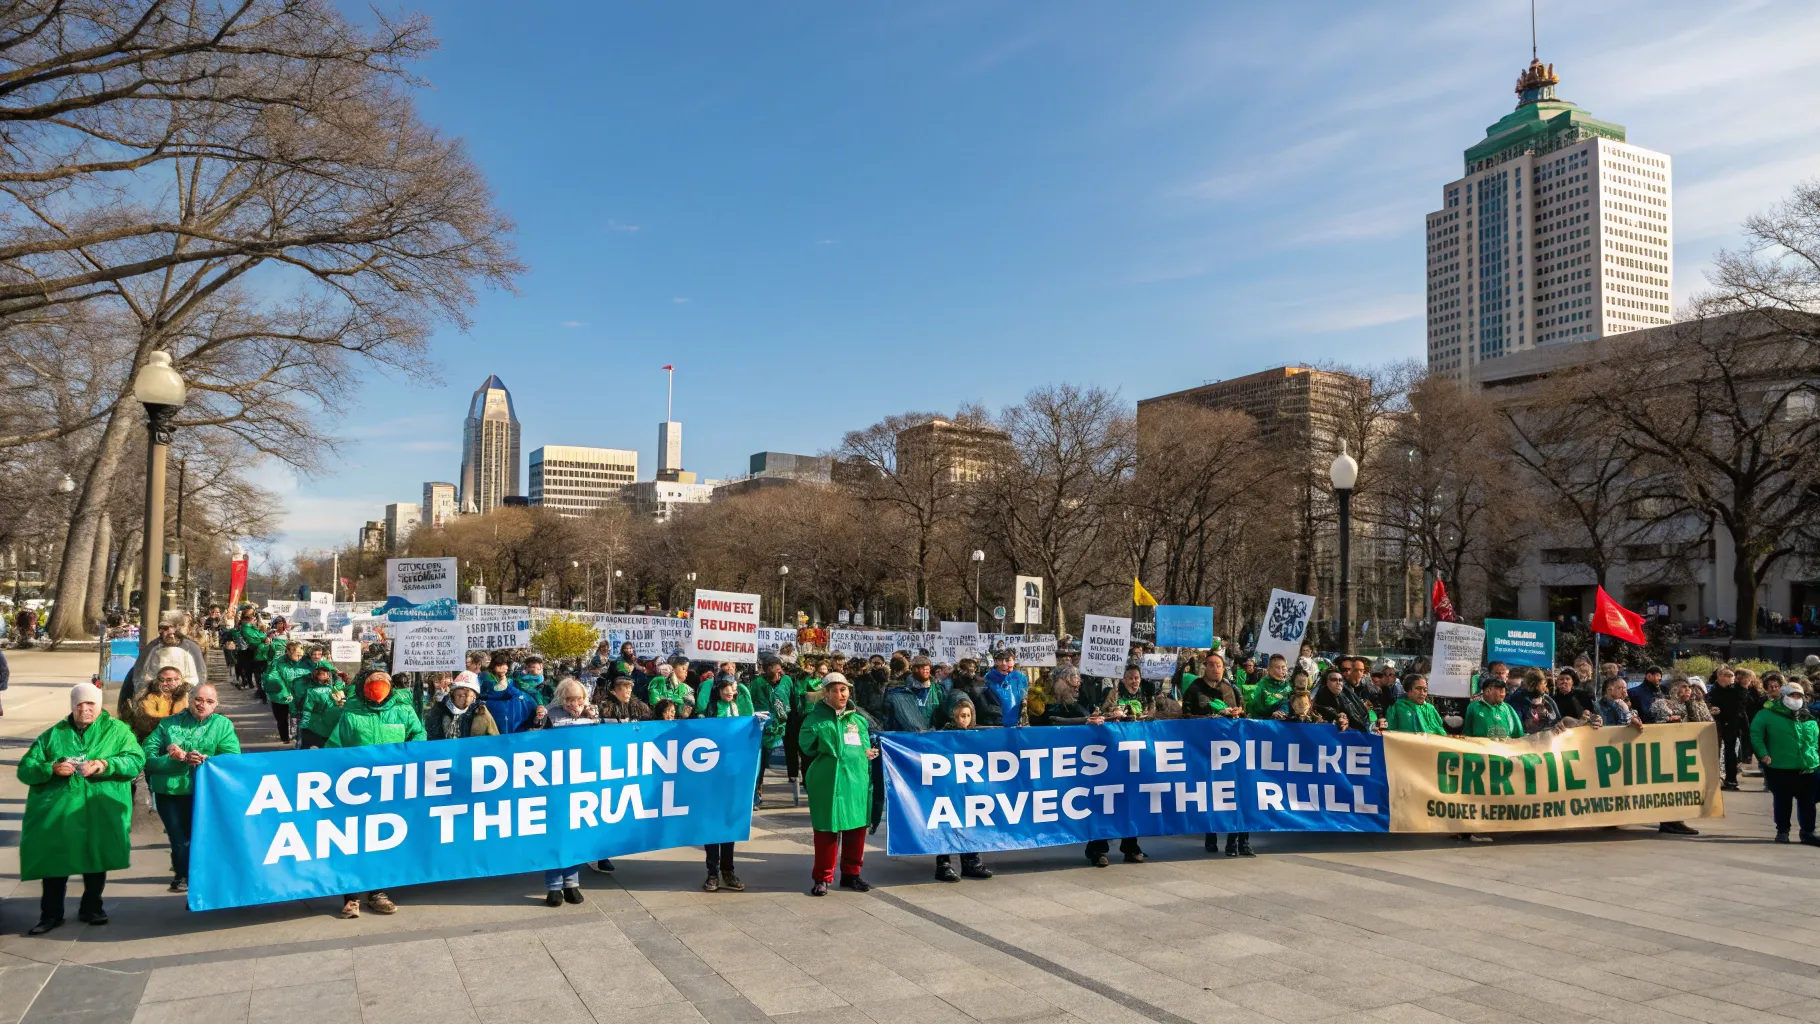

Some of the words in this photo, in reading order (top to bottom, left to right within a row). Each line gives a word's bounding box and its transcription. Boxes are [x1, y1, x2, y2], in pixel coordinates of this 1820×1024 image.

[244, 759, 453, 817] ARCTIE
[471, 737, 721, 794] DRILLING
[927, 784, 1127, 831] ARVECT
[1138, 781, 1238, 814] THE
[1256, 781, 1379, 815] RULL
[262, 812, 409, 866] AND
[429, 796, 547, 845] THE
